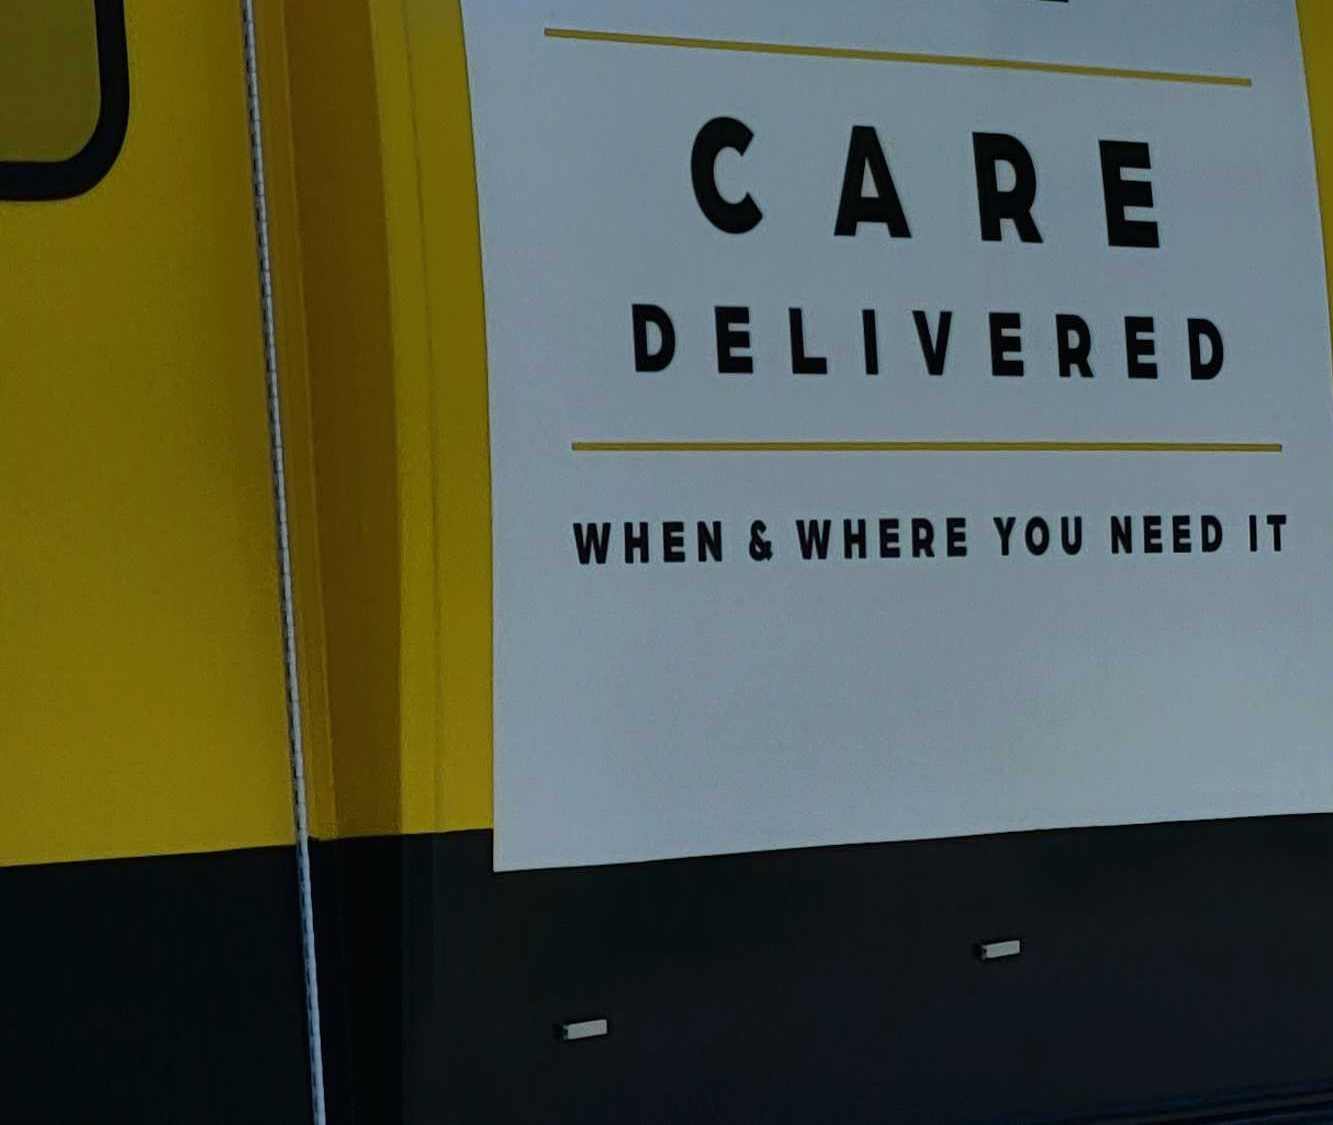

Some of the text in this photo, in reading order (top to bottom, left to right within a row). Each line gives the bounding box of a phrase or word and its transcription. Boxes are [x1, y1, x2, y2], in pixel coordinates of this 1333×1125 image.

[690, 116, 1161, 249] CARE
[631, 303, 1224, 381] DELIVERED
[572, 514, 1288, 565] WHEN & WHERE YOU NEED IT
